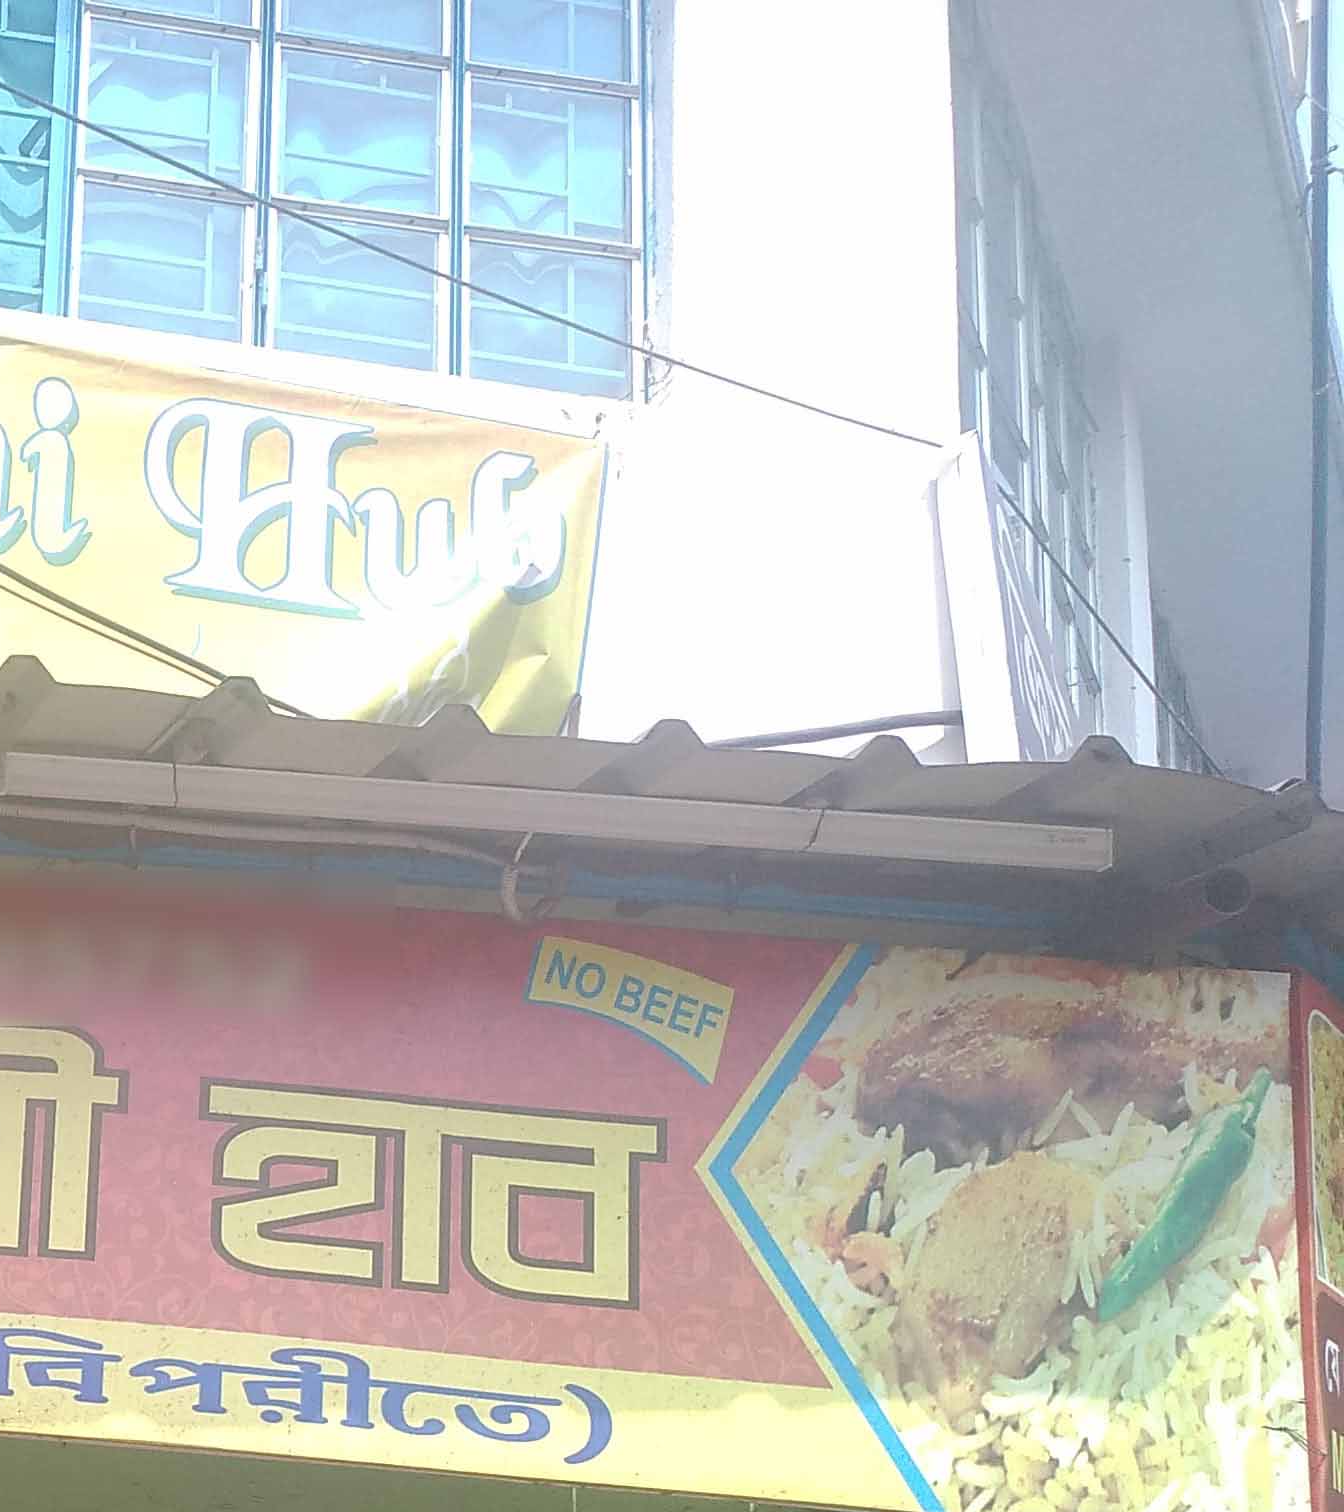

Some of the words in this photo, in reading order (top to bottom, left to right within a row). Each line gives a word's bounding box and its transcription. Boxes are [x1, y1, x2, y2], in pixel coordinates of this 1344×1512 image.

[144, 393, 569, 622] Hub
[542, 948, 604, 1003] NO
[612, 973, 725, 1040] BEEF
[198, 1075, 668, 1310] হাব
